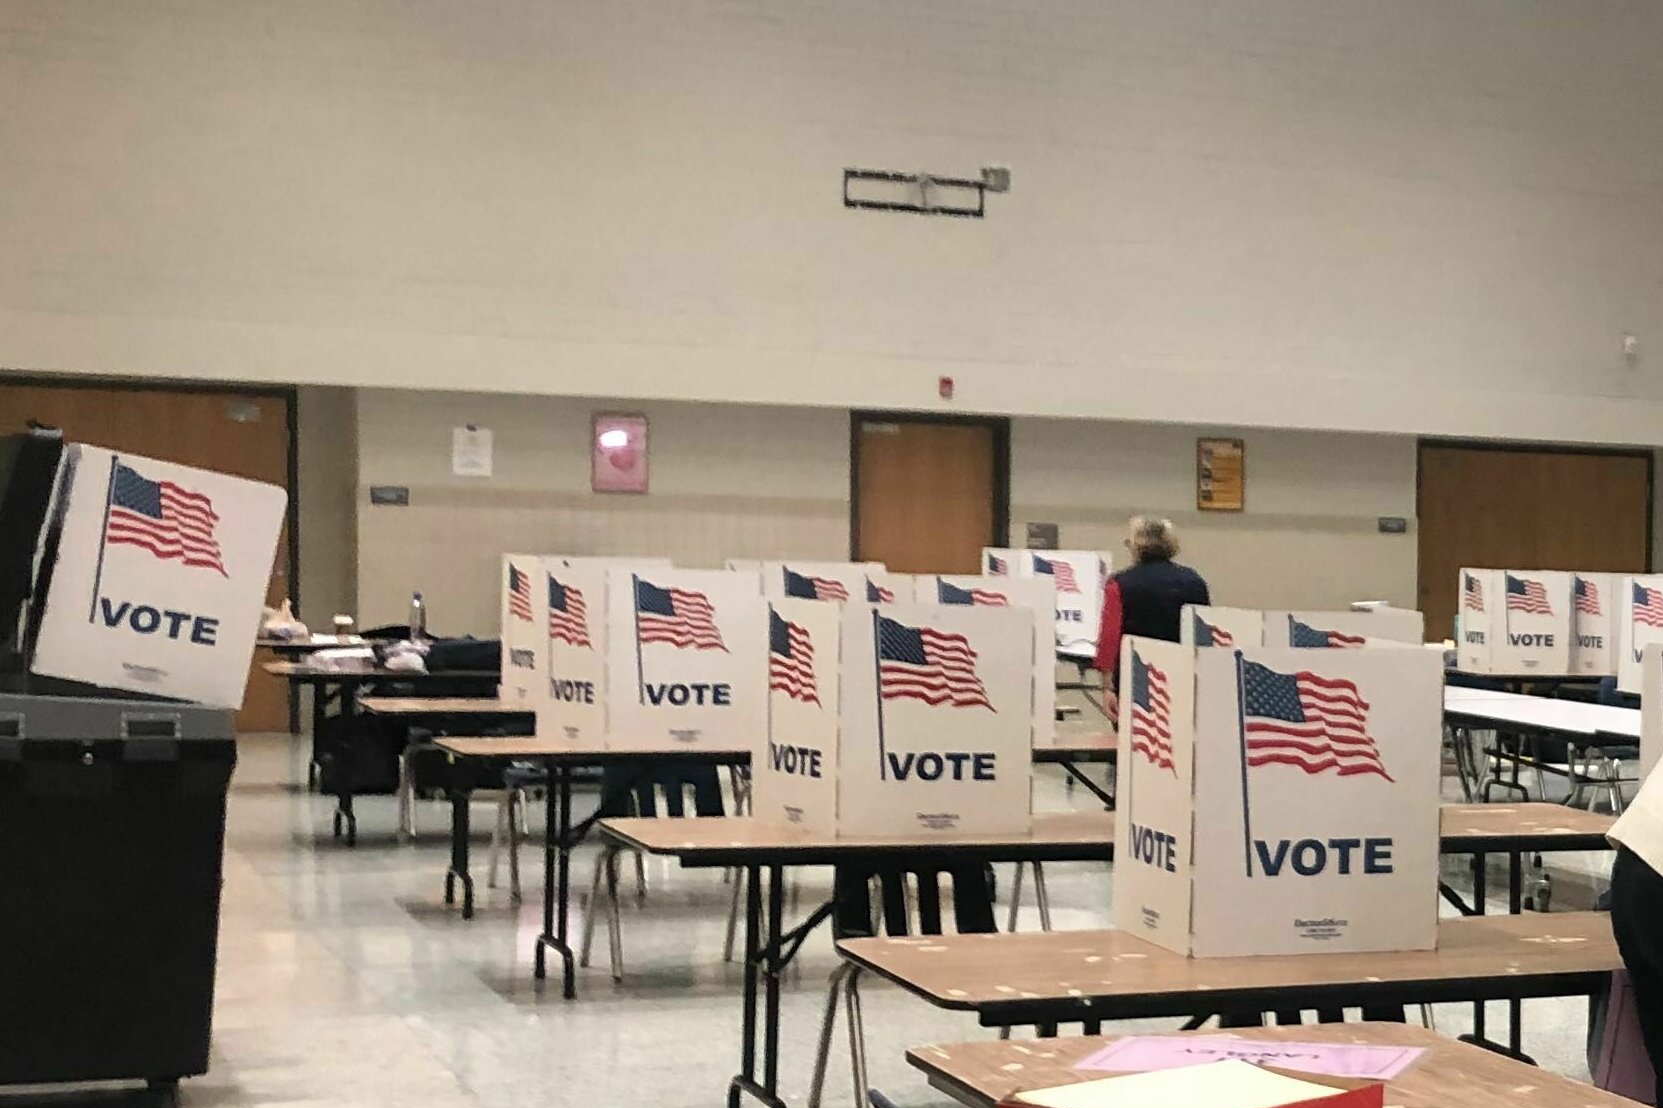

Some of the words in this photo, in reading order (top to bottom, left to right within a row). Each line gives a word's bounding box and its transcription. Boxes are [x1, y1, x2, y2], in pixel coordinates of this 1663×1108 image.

[100, 597, 219, 646] VOTE
[1055, 608, 1083, 622] TE
[1465, 631, 1485, 644] VOTE
[1510, 633, 1555, 648] VOTE
[1577, 633, 1603, 649] VOTE
[550, 677, 595, 704] VOTE
[645, 683, 731, 706] VOTE
[772, 743, 822, 779] VOTE
[887, 752, 996, 781] VOTE
[1132, 823, 1176, 873] VOTE
[1254, 837, 1394, 876] VOTE
